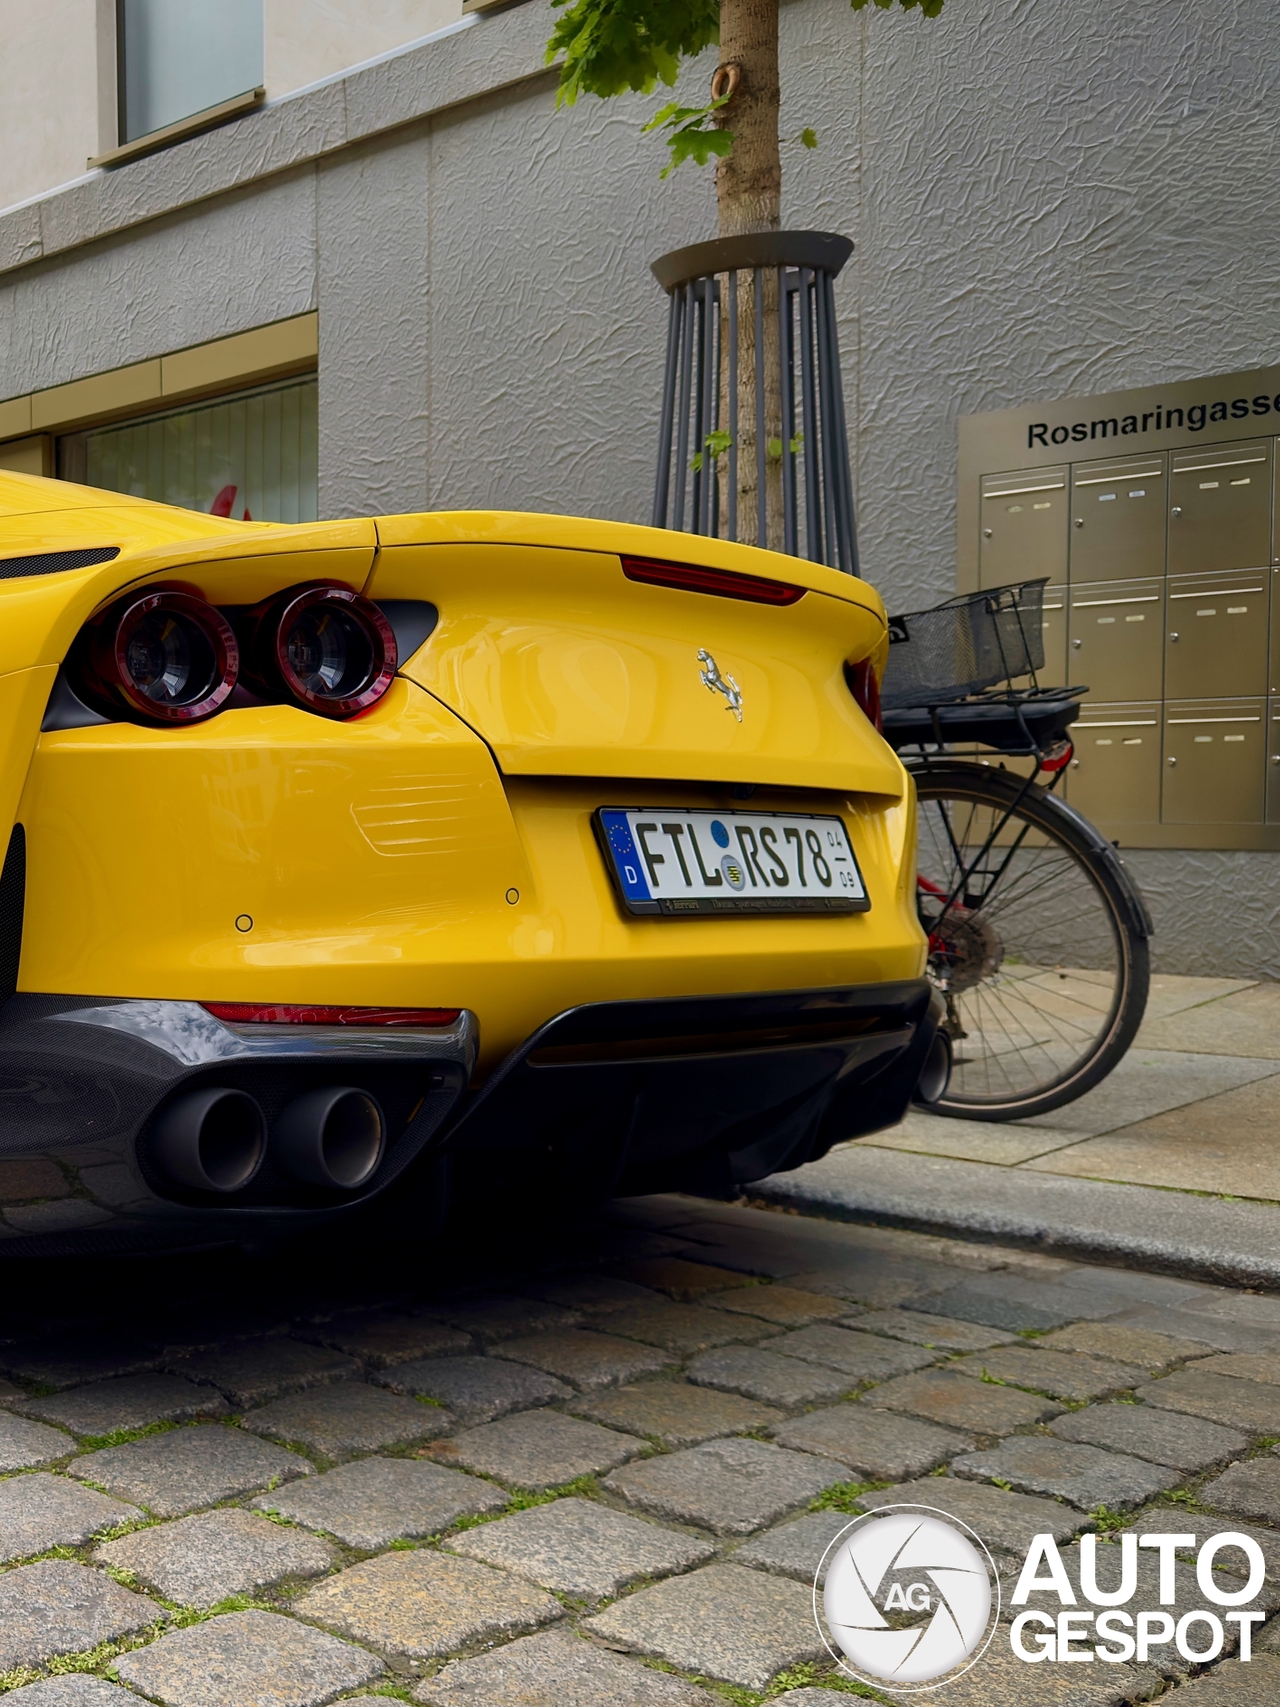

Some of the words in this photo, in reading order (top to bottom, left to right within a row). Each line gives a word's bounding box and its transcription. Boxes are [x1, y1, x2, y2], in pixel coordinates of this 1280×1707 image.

[826, 831, 843, 848] 04
[635, 823, 722, 887] FTL
[734, 825, 833, 887] RS78
[624, 865, 638, 884] D
[840, 871, 855, 888] 09
